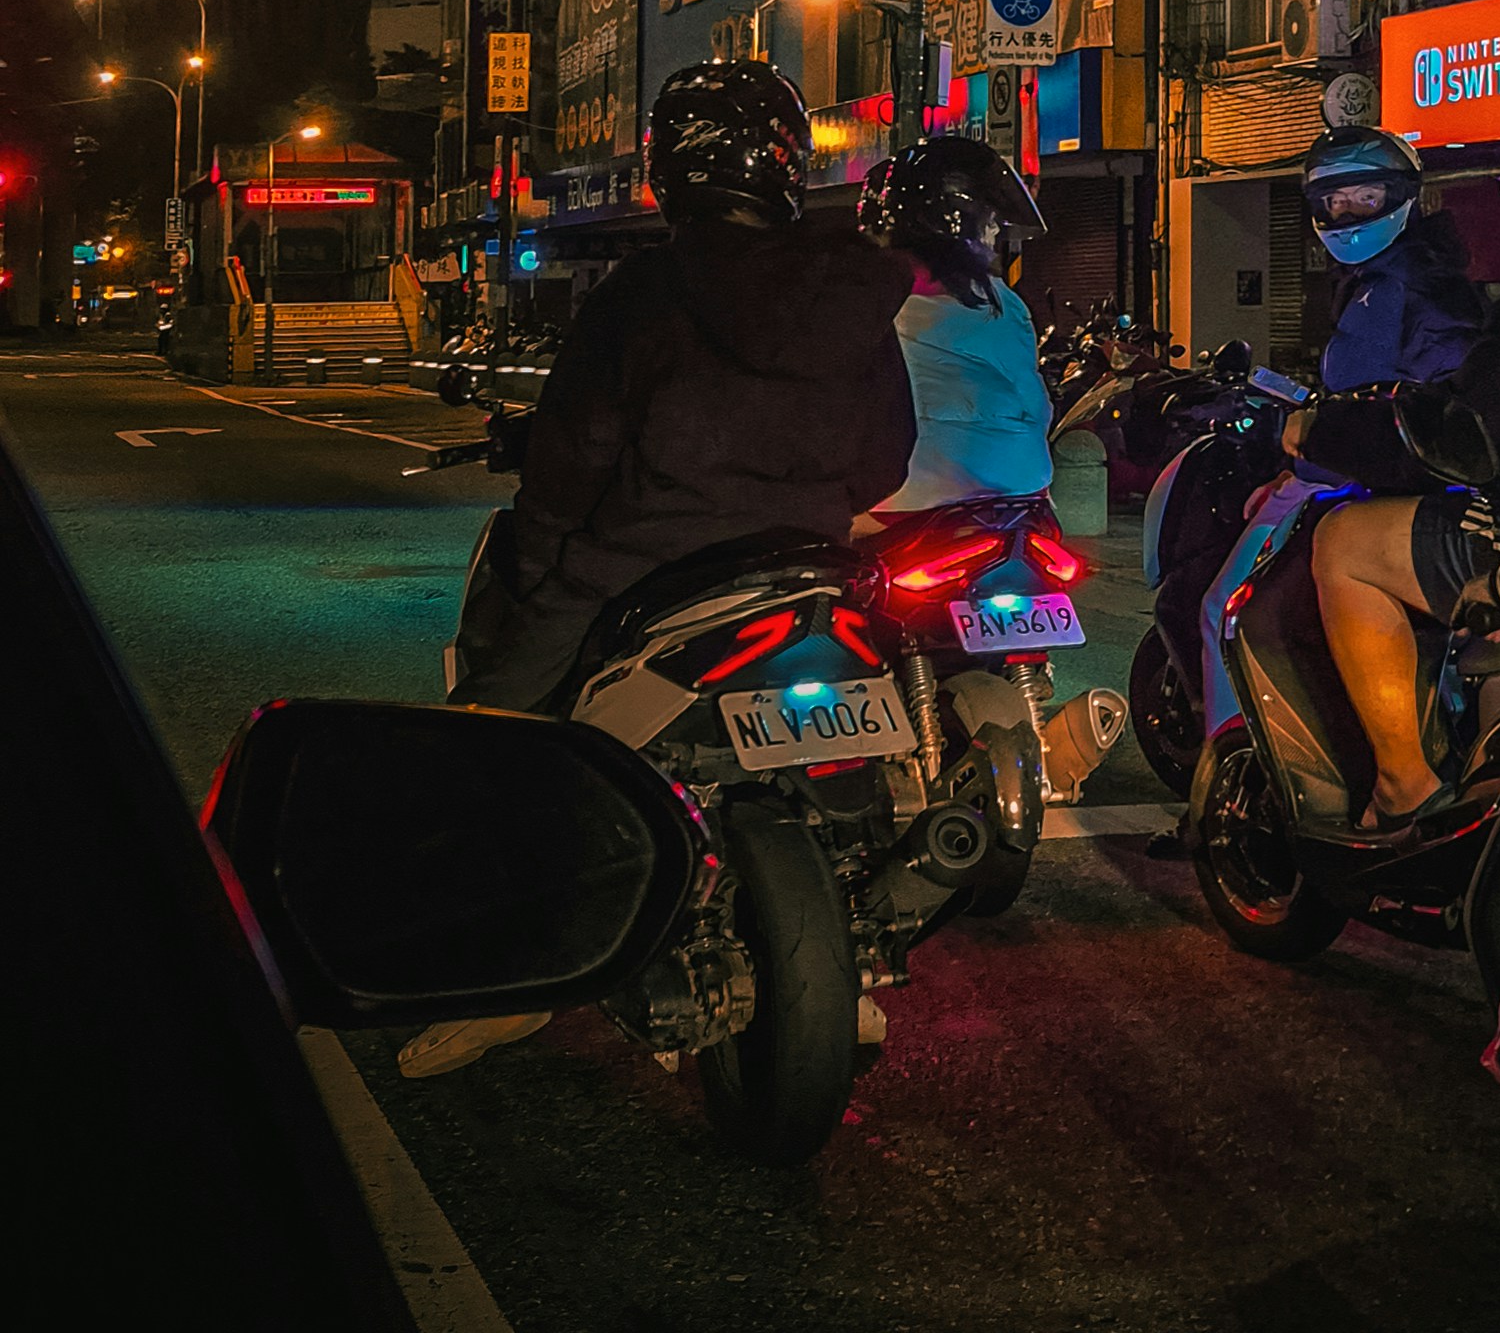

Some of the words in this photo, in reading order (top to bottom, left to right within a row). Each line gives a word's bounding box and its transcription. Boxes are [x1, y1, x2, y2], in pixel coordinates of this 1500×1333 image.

[988, 31, 1054, 48] 行人優先
[957, 607, 1074, 639] PAV-5619
[731, 697, 900, 750] NLV-0061
